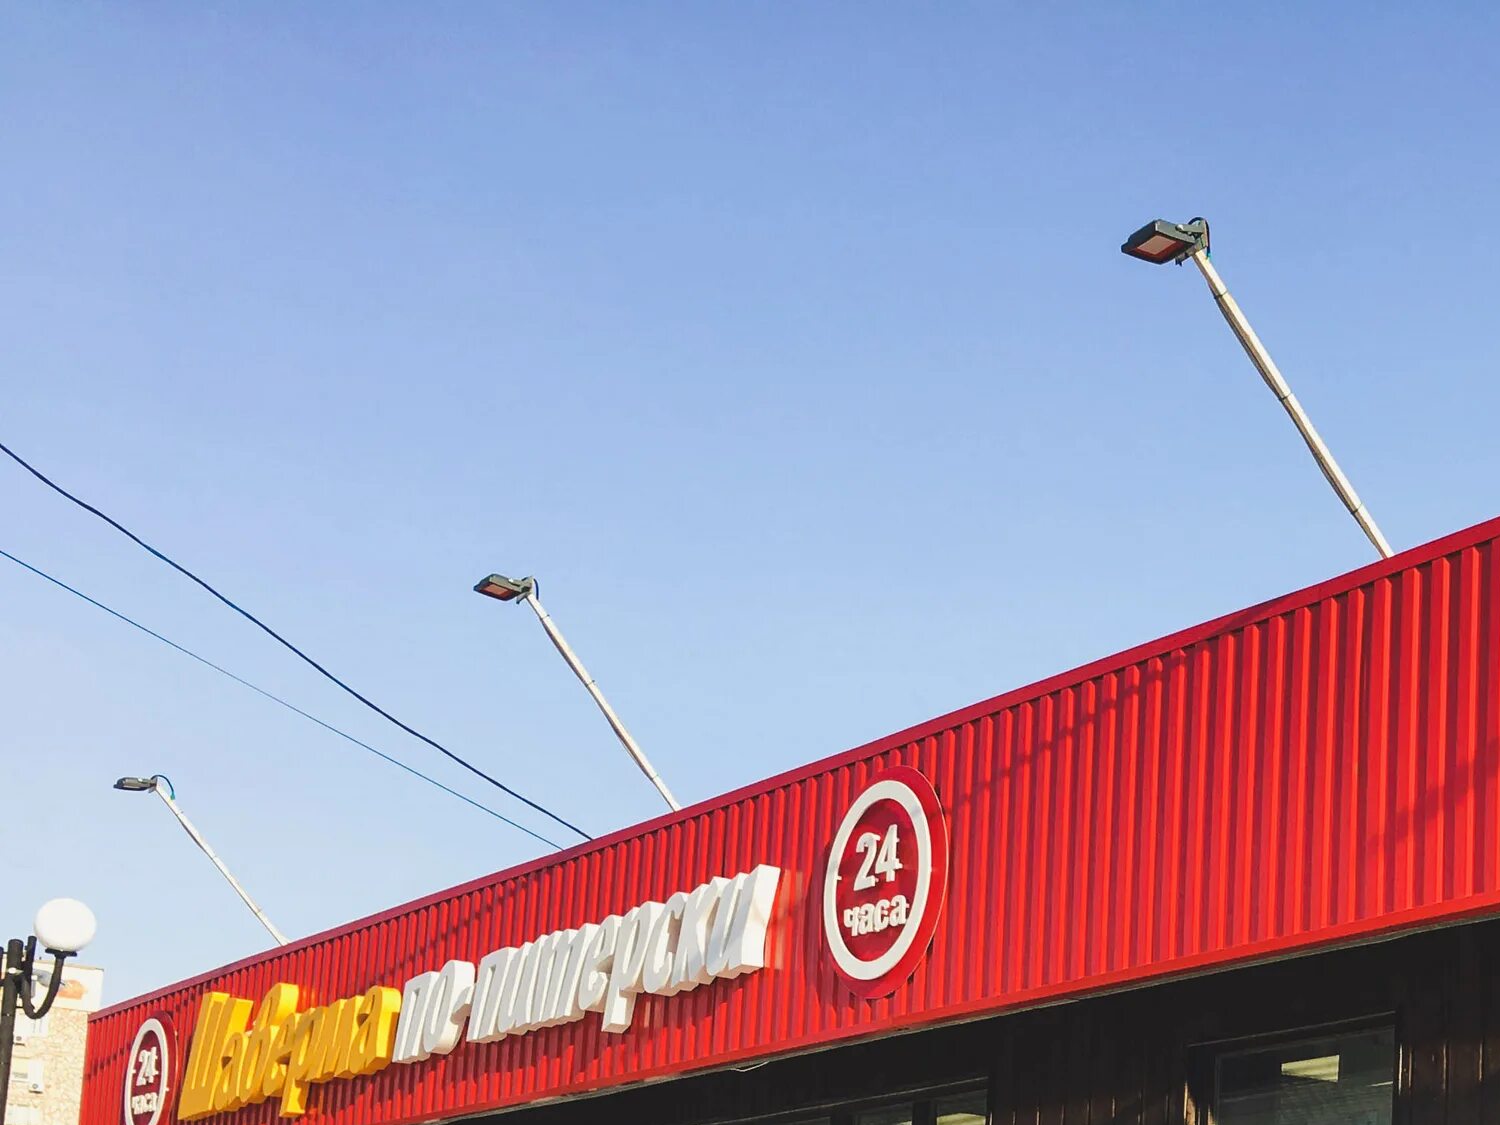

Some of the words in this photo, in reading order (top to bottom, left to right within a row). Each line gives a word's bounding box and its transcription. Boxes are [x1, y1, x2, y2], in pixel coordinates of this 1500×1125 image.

[853, 823, 904, 892] 24
[843, 893, 910, 937] часа
[178, 983, 401, 1121] Шаверма
[392, 863, 781, 1064] по-питерски
[136, 1046, 159, 1086] 24
